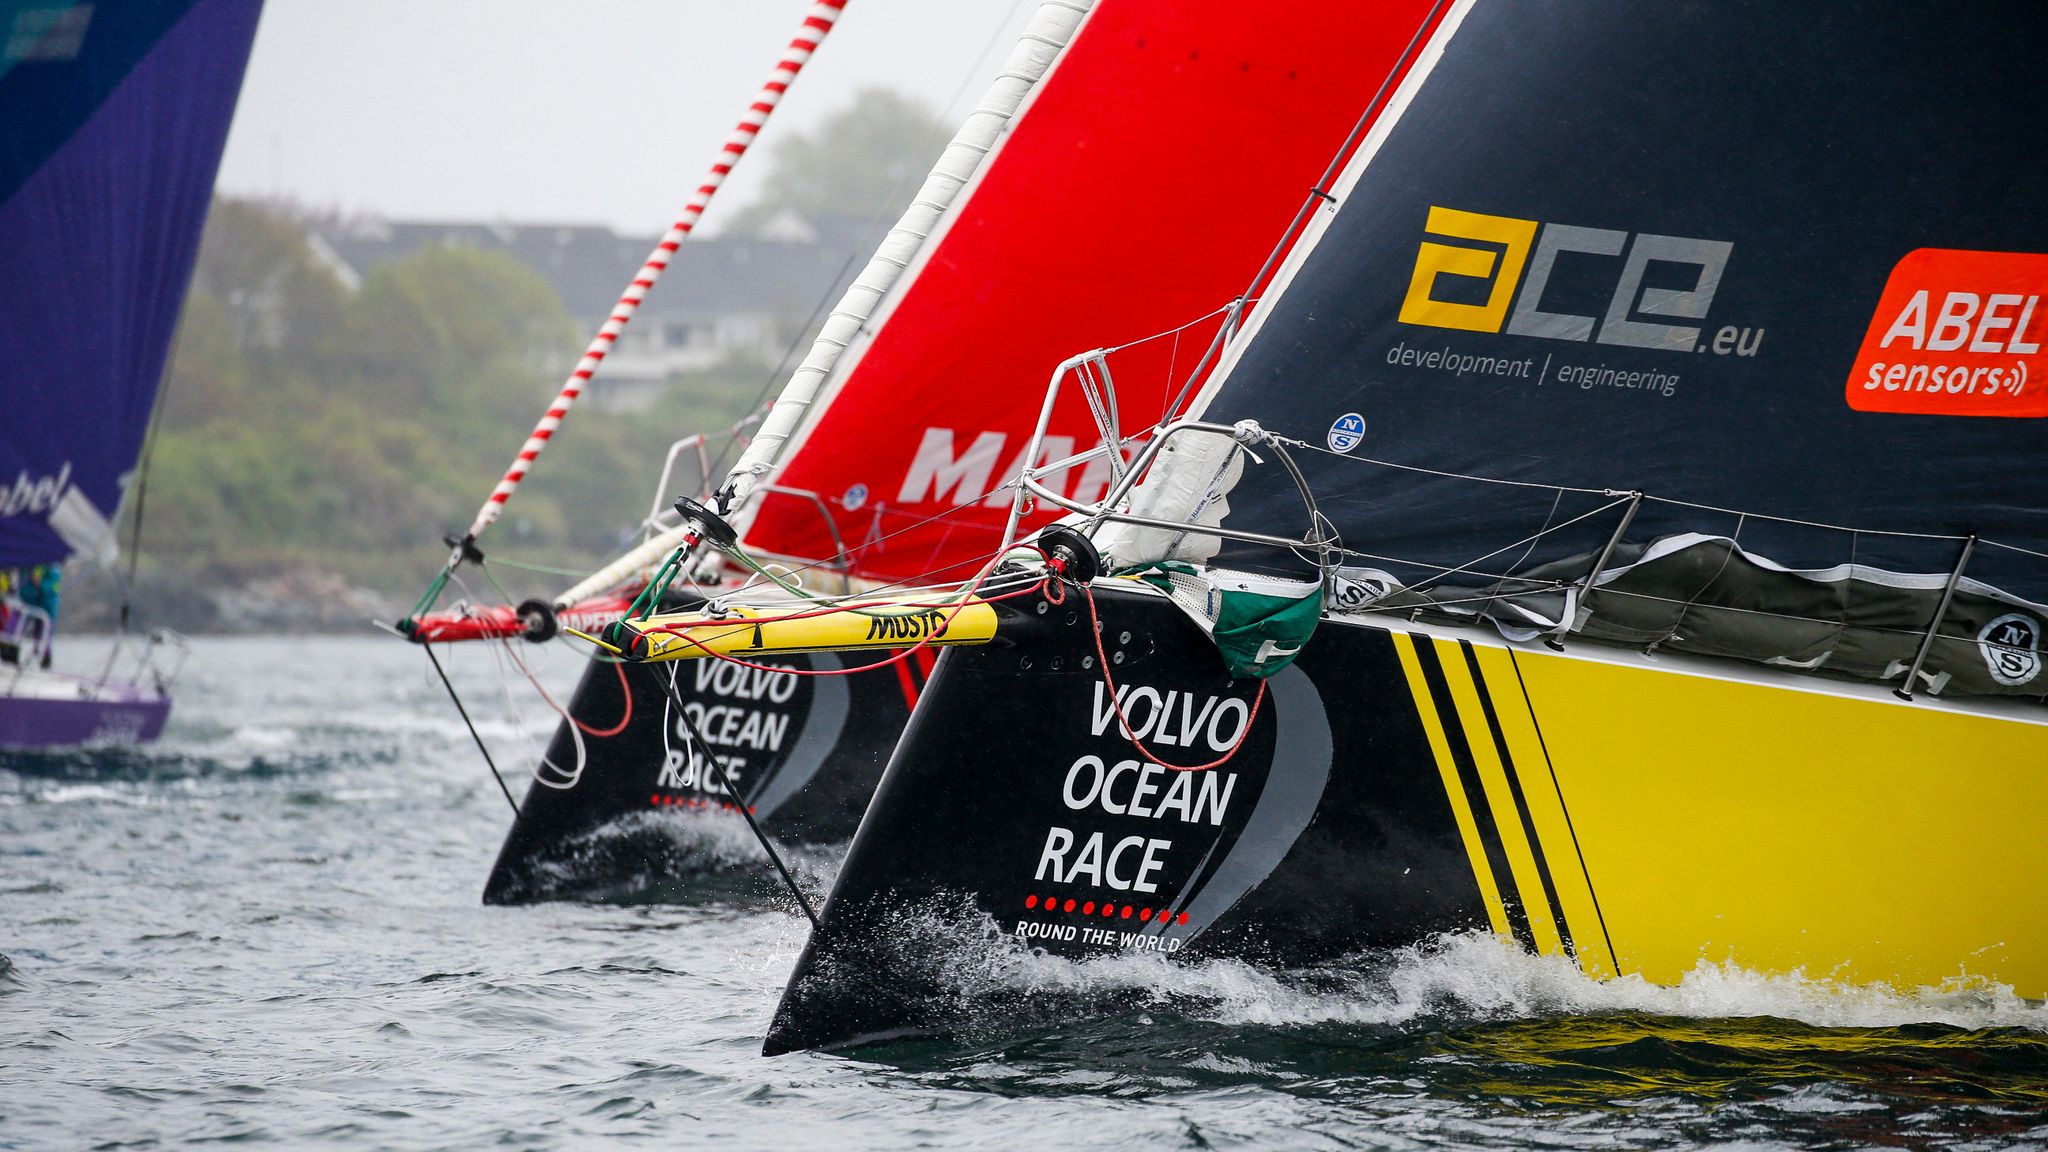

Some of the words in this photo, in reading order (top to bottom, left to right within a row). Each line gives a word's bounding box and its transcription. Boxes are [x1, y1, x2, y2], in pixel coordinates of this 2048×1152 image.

[1879, 290, 2040, 354] ABEL
[1386, 342, 1533, 377] development
[1557, 363, 1680, 397] engineering
[1863, 362, 2004, 395] sensors
[866, 610, 948, 640] MUSTO
[1999, 625, 2029, 645] N
[696, 657, 798, 703] VOLVO
[2001, 652, 2022, 672] S
[676, 702, 789, 752] OCEAN
[1091, 680, 1249, 752] VOLVO
[656, 748, 747, 796] RACE
[1062, 754, 1238, 826] OCEAN
[1034, 826, 1172, 893] RACE
[1015, 921, 1077, 942] ROUND
[1082, 928, 1116, 946] THE
[1119, 931, 1181, 953] WORLD
